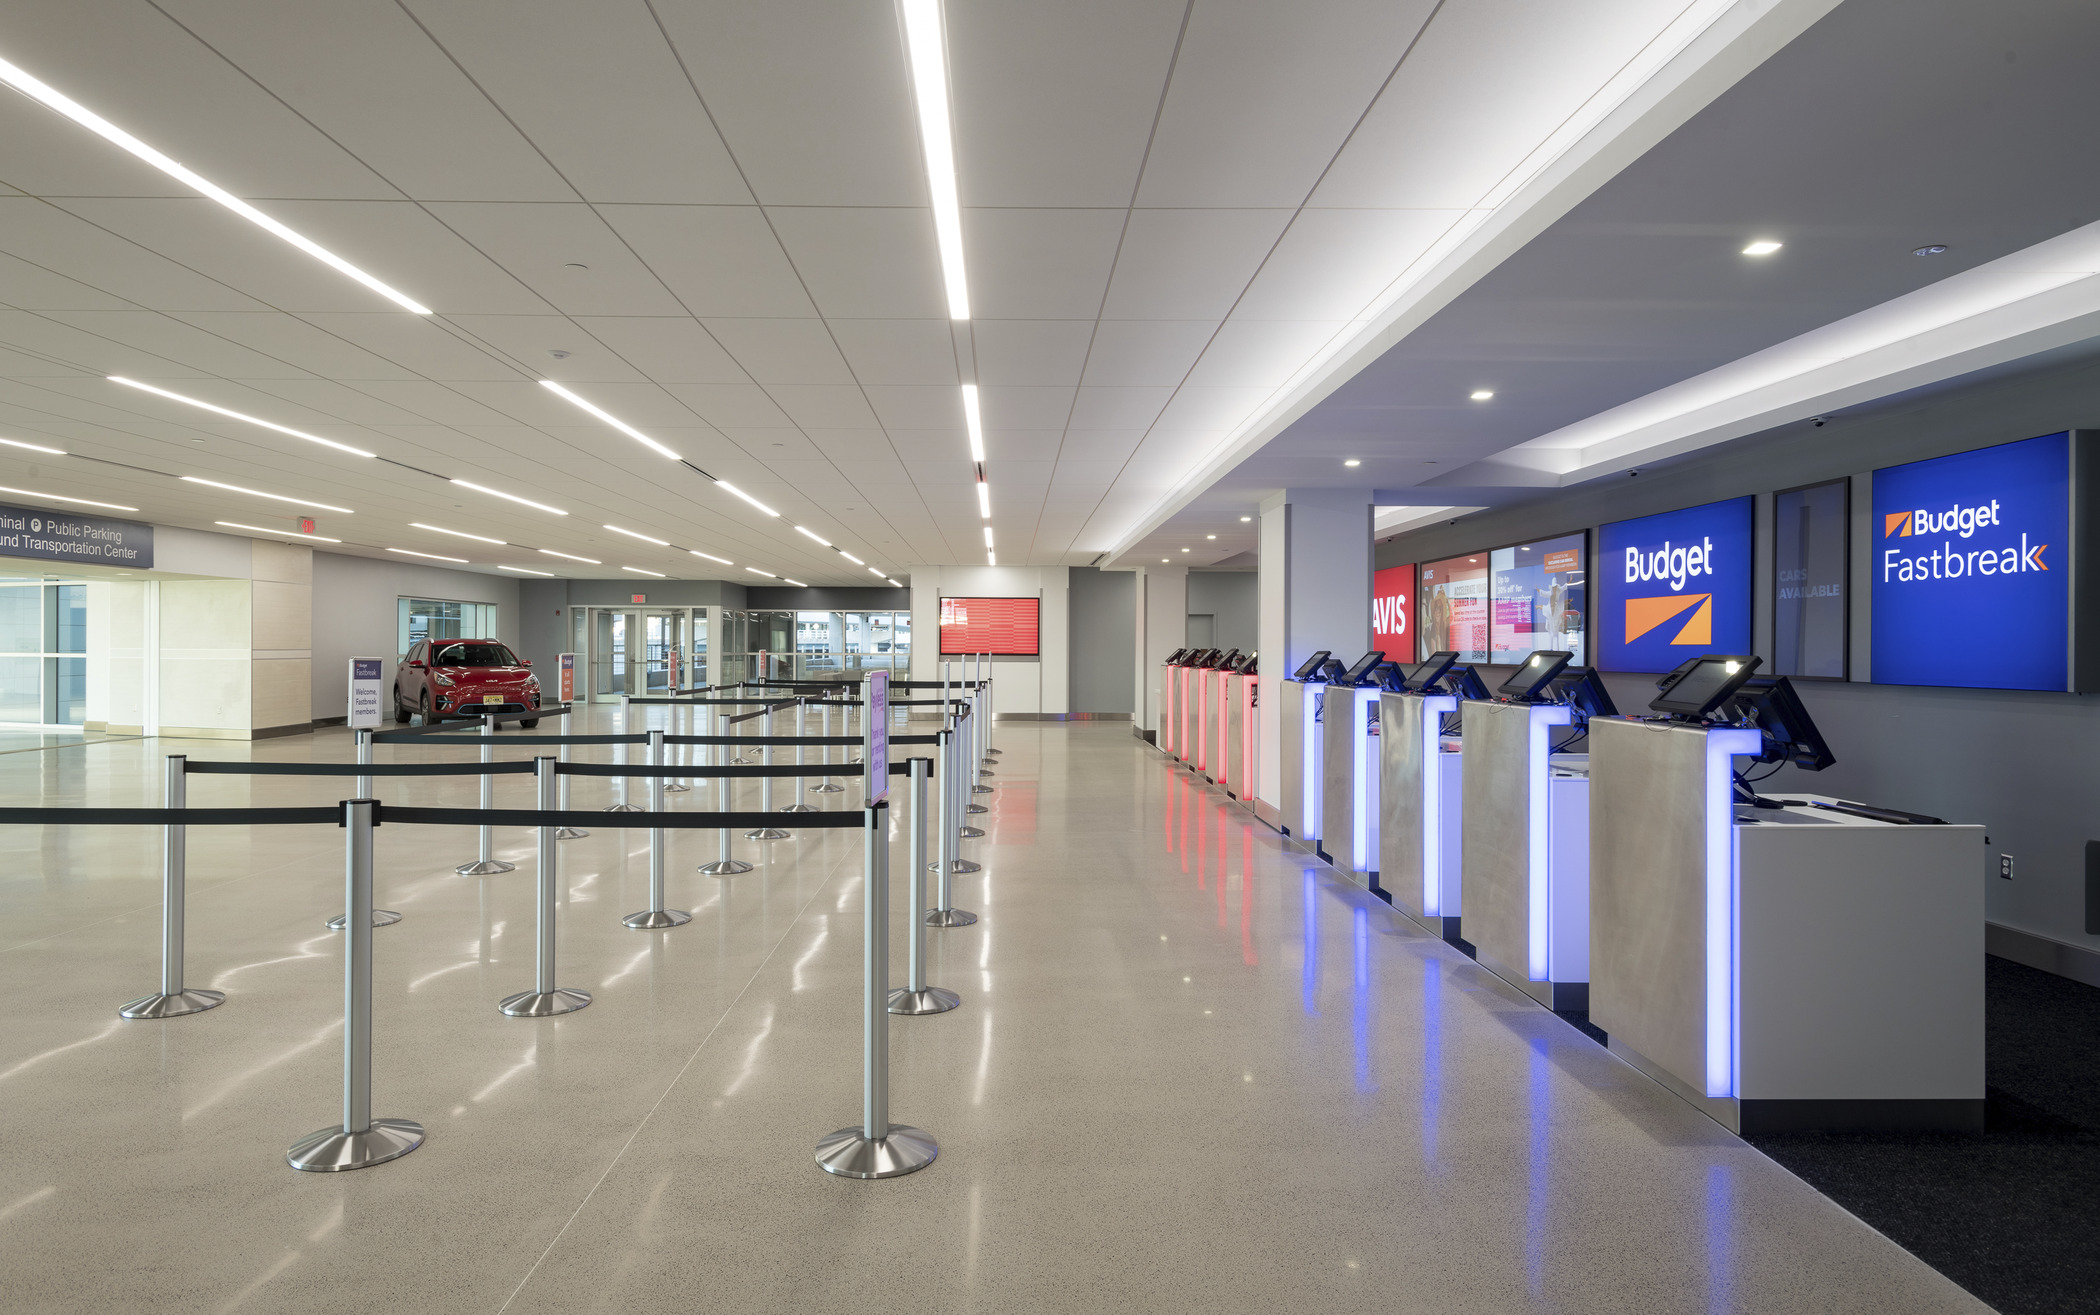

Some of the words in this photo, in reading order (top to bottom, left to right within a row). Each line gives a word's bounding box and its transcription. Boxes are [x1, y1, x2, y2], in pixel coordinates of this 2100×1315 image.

[1915, 499, 2000, 538] Budget
[47, 520, 81, 537] Public
[83, 525, 122, 544] Parking
[22, 534, 102, 556] Transportation
[104, 544, 138, 559] Center
[1625, 536, 1713, 591] Budget
[1884, 532, 2042, 583] Fastbreak
[1424, 569, 1433, 580] AVIS
[1497, 576, 1504, 585] Up
[1504, 575, 1510, 583] to
[1779, 568, 1807, 582] CARS
[1778, 584, 1840, 600] AVAILABLE
[1373, 594, 1406, 635] AVIS
[356, 668, 377, 676] Fastbreak
[355, 687, 377, 696] Welcome,
[355, 697, 377, 706] Fastbreak
[355, 707, 377, 715] members.
